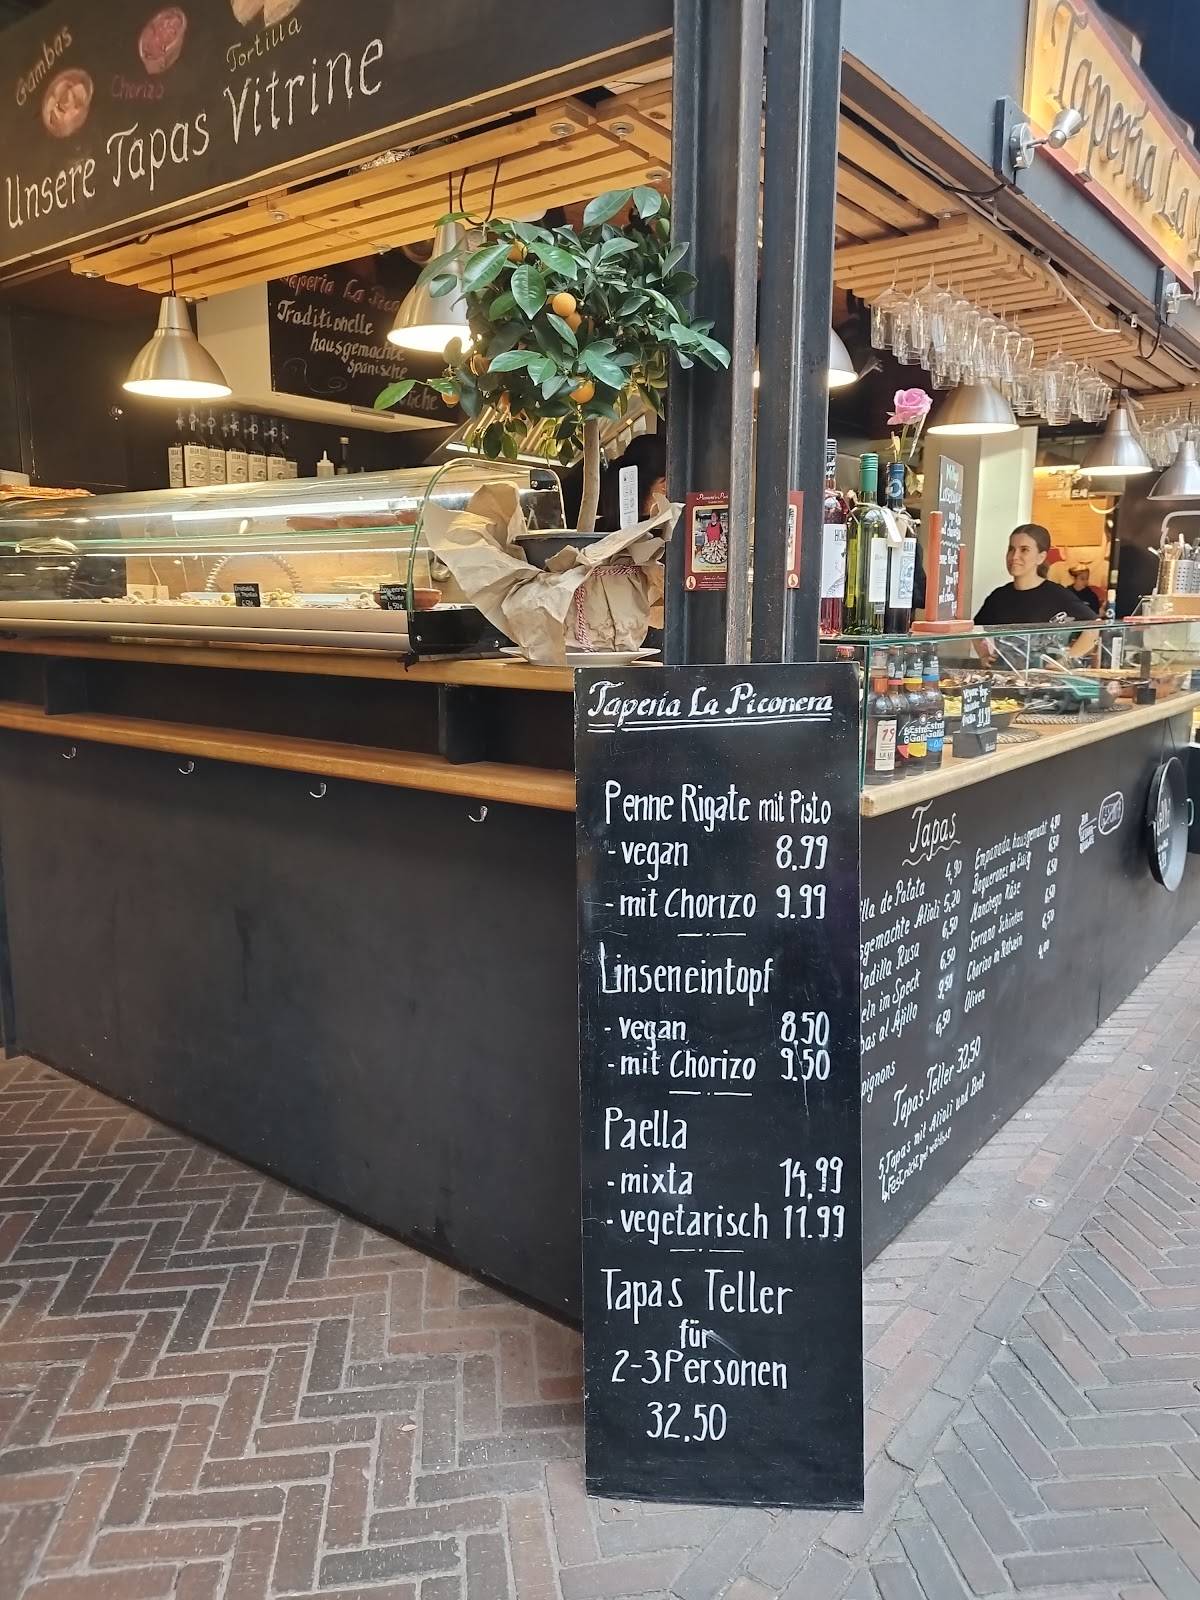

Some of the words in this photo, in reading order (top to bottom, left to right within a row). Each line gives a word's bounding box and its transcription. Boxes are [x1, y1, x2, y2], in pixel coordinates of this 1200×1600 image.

[226, 16, 303, 72] Tortilla
[16, 25, 73, 106] Gambas
[5, 157, 97, 229] Unsere
[106, 111, 211, 192] Tapas
[222, 37, 385, 145] Vitrine
[276, 299, 375, 336] Traditionelle
[310, 330, 406, 363] hausgemachte
[688, 686, 720, 717] La
[724, 682, 834, 714] Piconera
[605, 780, 674, 824] Penne
[681, 783, 751, 832] Rigate
[758, 790, 785, 823] mit
[790, 789, 832, 825] Pisto
[909, 799, 958, 861] Tapas
[775, 834, 829, 872] 8.99
[1009, 857, 1017, 873] in
[663, 887, 757, 919] Chorizo
[775, 884, 827, 920] 9.99
[880, 889, 893, 915] de
[894, 876, 926, 906] Patata
[945, 859, 963, 885] 4,90
[913, 899, 941, 929] Alioli
[943, 888, 961, 913] 5,20
[895, 942, 920, 970] Rusa
[941, 915, 959, 940] 6,50
[968, 924, 996, 953] Serrano
[599, 941, 774, 1006] Linseneintopf
[879, 991, 891, 1013] im
[892, 968, 921, 1009] Speck
[940, 945, 957, 970] 6,50
[966, 955, 993, 982] Chorizo
[993, 947, 1000, 963] in
[964, 987, 986, 1013] Oliven
[879, 1016, 890, 1042] al
[890, 1001, 918, 1038] Ajillo
[935, 1008, 952, 1038] 6,50
[669, 1049, 757, 1081] Chorizo
[780, 1049, 831, 1082] 9.50
[893, 1083, 925, 1128] Tapas
[926, 1061, 955, 1101] Teller
[955, 1035, 981, 1073] 32,50
[604, 1106, 688, 1150] Paella
[913, 1120, 927, 1146] mit
[929, 1099, 954, 1132] Alioli
[955, 1081, 970, 1112] und
[970, 1070, 986, 1097] Brot
[783, 1204, 846, 1240] 11.99
[600, 1268, 684, 1325] Tapas
[704, 1268, 794, 1315] Teller
[679, 1318, 714, 1349] für
[646, 1401, 727, 1443] 32.50
